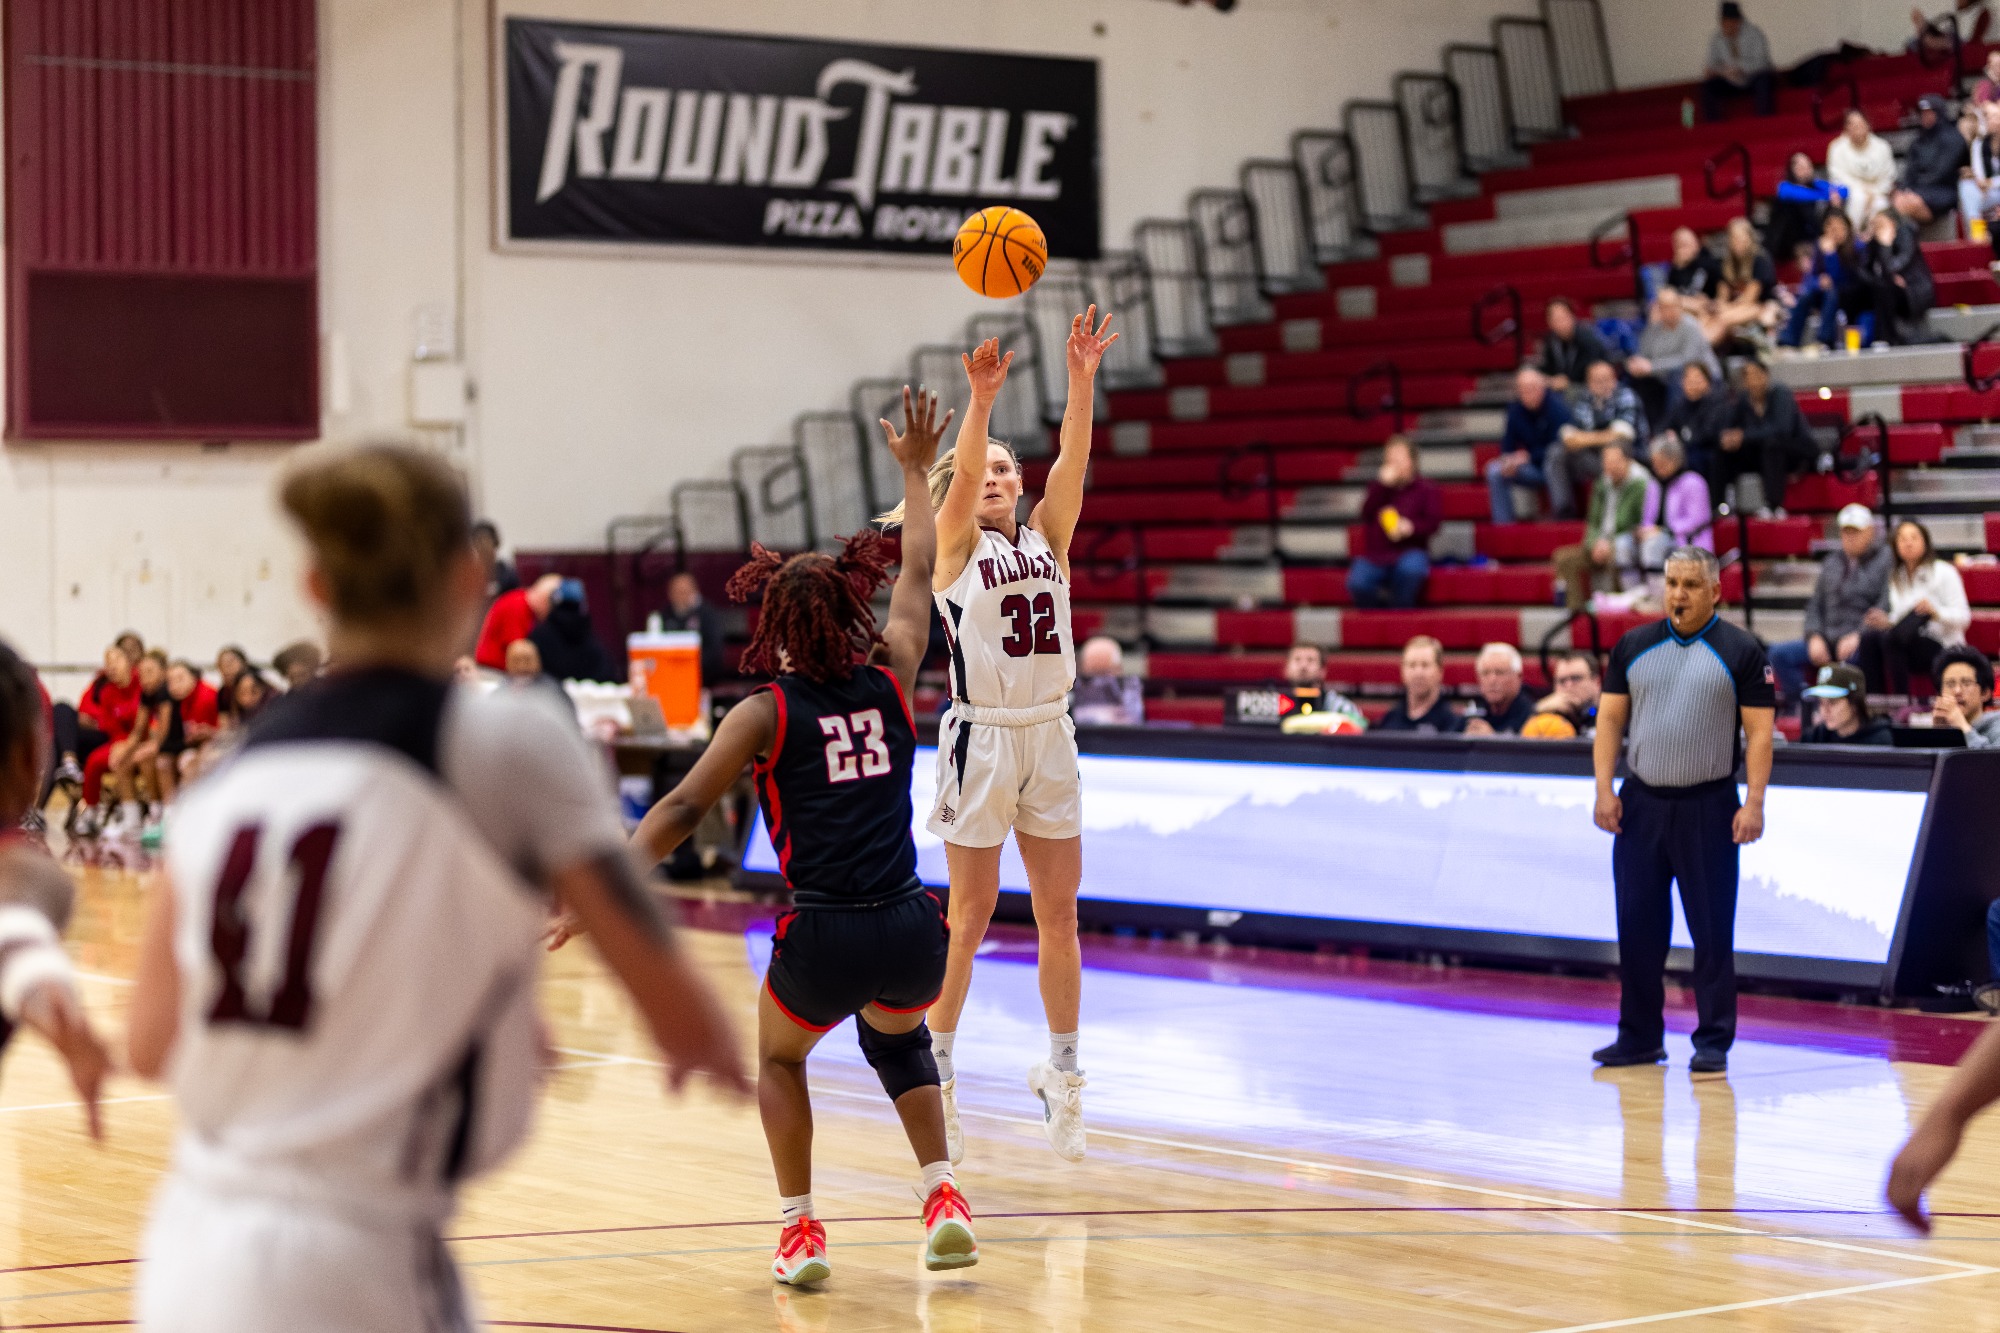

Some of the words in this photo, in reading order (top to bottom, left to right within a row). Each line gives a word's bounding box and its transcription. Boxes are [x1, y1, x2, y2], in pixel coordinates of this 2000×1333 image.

[535, 40, 849, 204] ROUND
[817, 58, 1077, 212] TABLE
[763, 198, 863, 238] PIZZA
[1000, 592, 1062, 658] 32
[817, 708, 892, 784] 23
